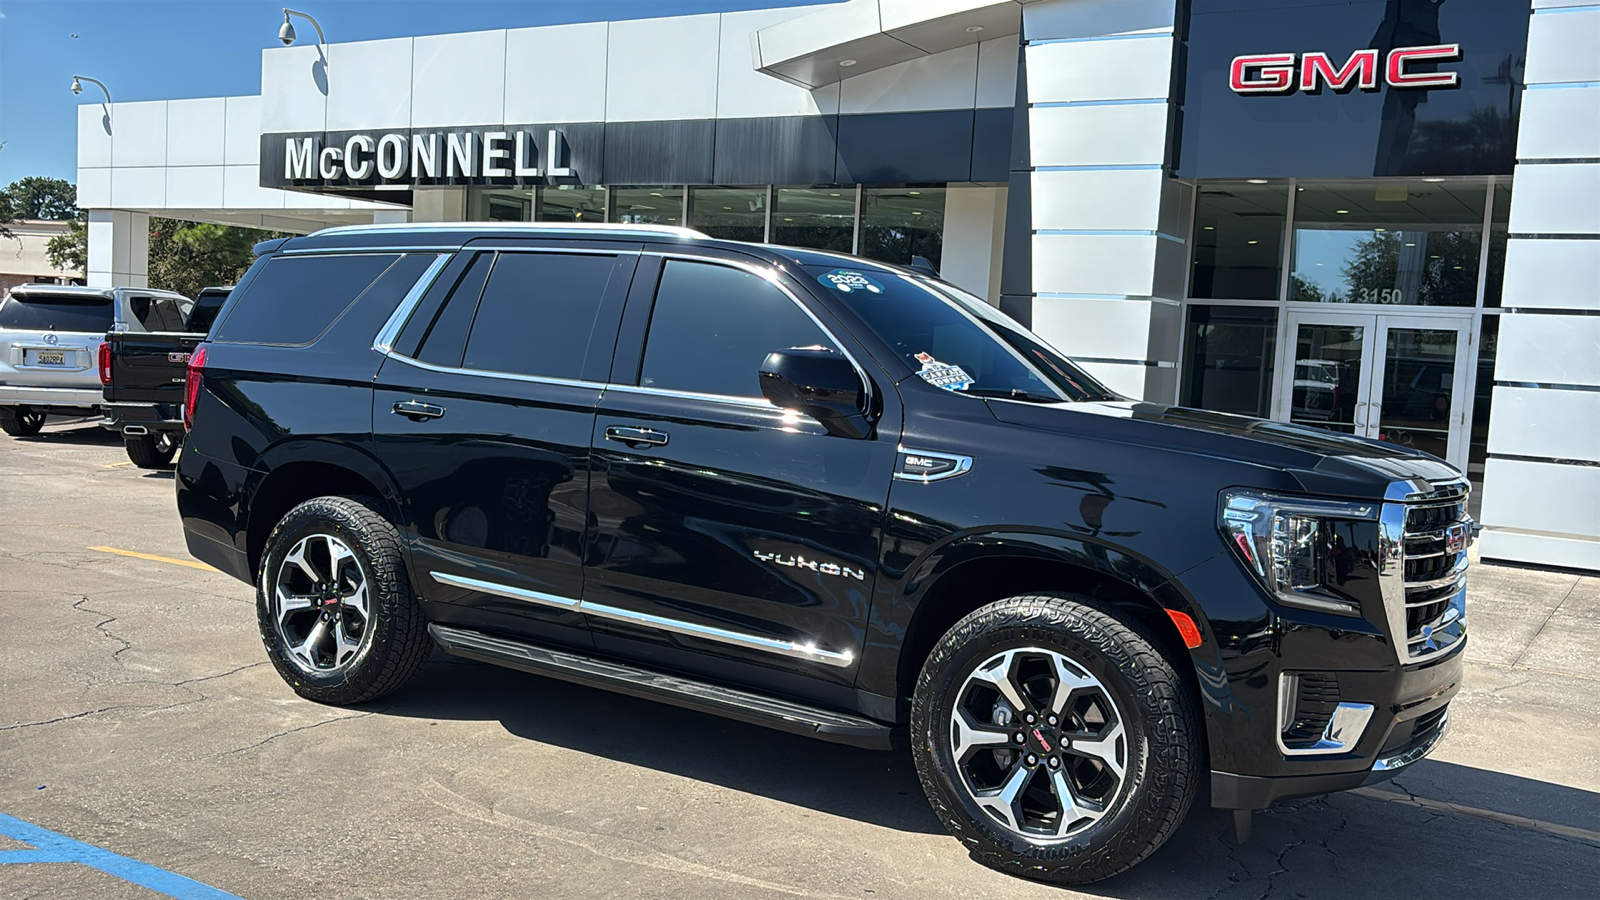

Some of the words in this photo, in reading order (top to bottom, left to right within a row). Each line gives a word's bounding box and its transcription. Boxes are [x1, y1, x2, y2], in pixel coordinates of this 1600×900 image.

[1229, 44, 1460, 92] GMC
[284, 130, 572, 179] McCONNELL
[1359, 288, 1402, 304] 3150
[905, 456, 934, 467] GMC
[753, 550, 865, 581] YUKON
